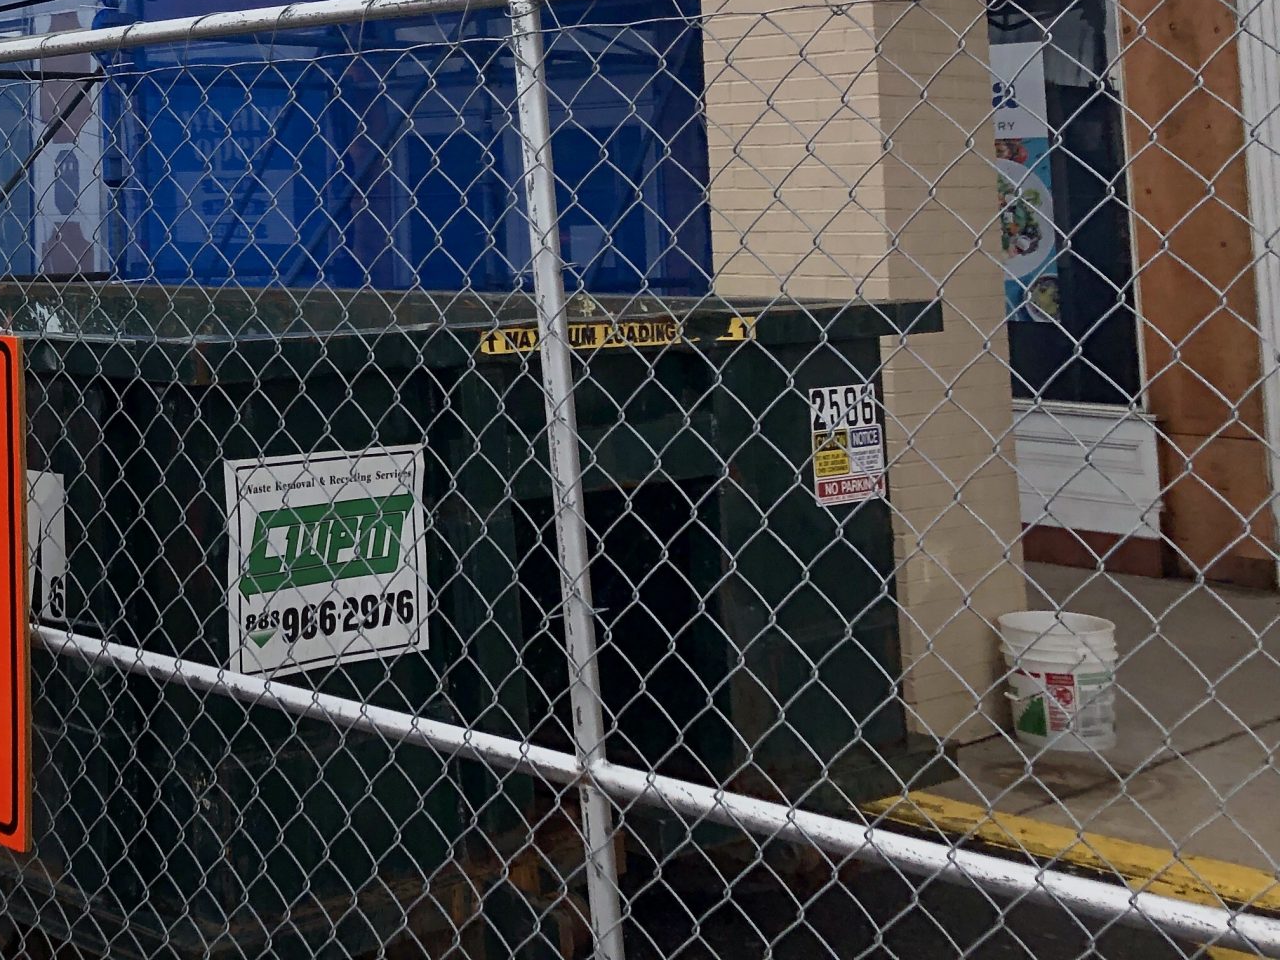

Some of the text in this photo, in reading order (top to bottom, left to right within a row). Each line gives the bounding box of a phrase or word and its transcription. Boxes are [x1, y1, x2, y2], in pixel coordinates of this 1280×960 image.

[605, 323, 676, 345] LOADING
[852, 430, 879, 447] NOTICE
[824, 481, 839, 496] NO
